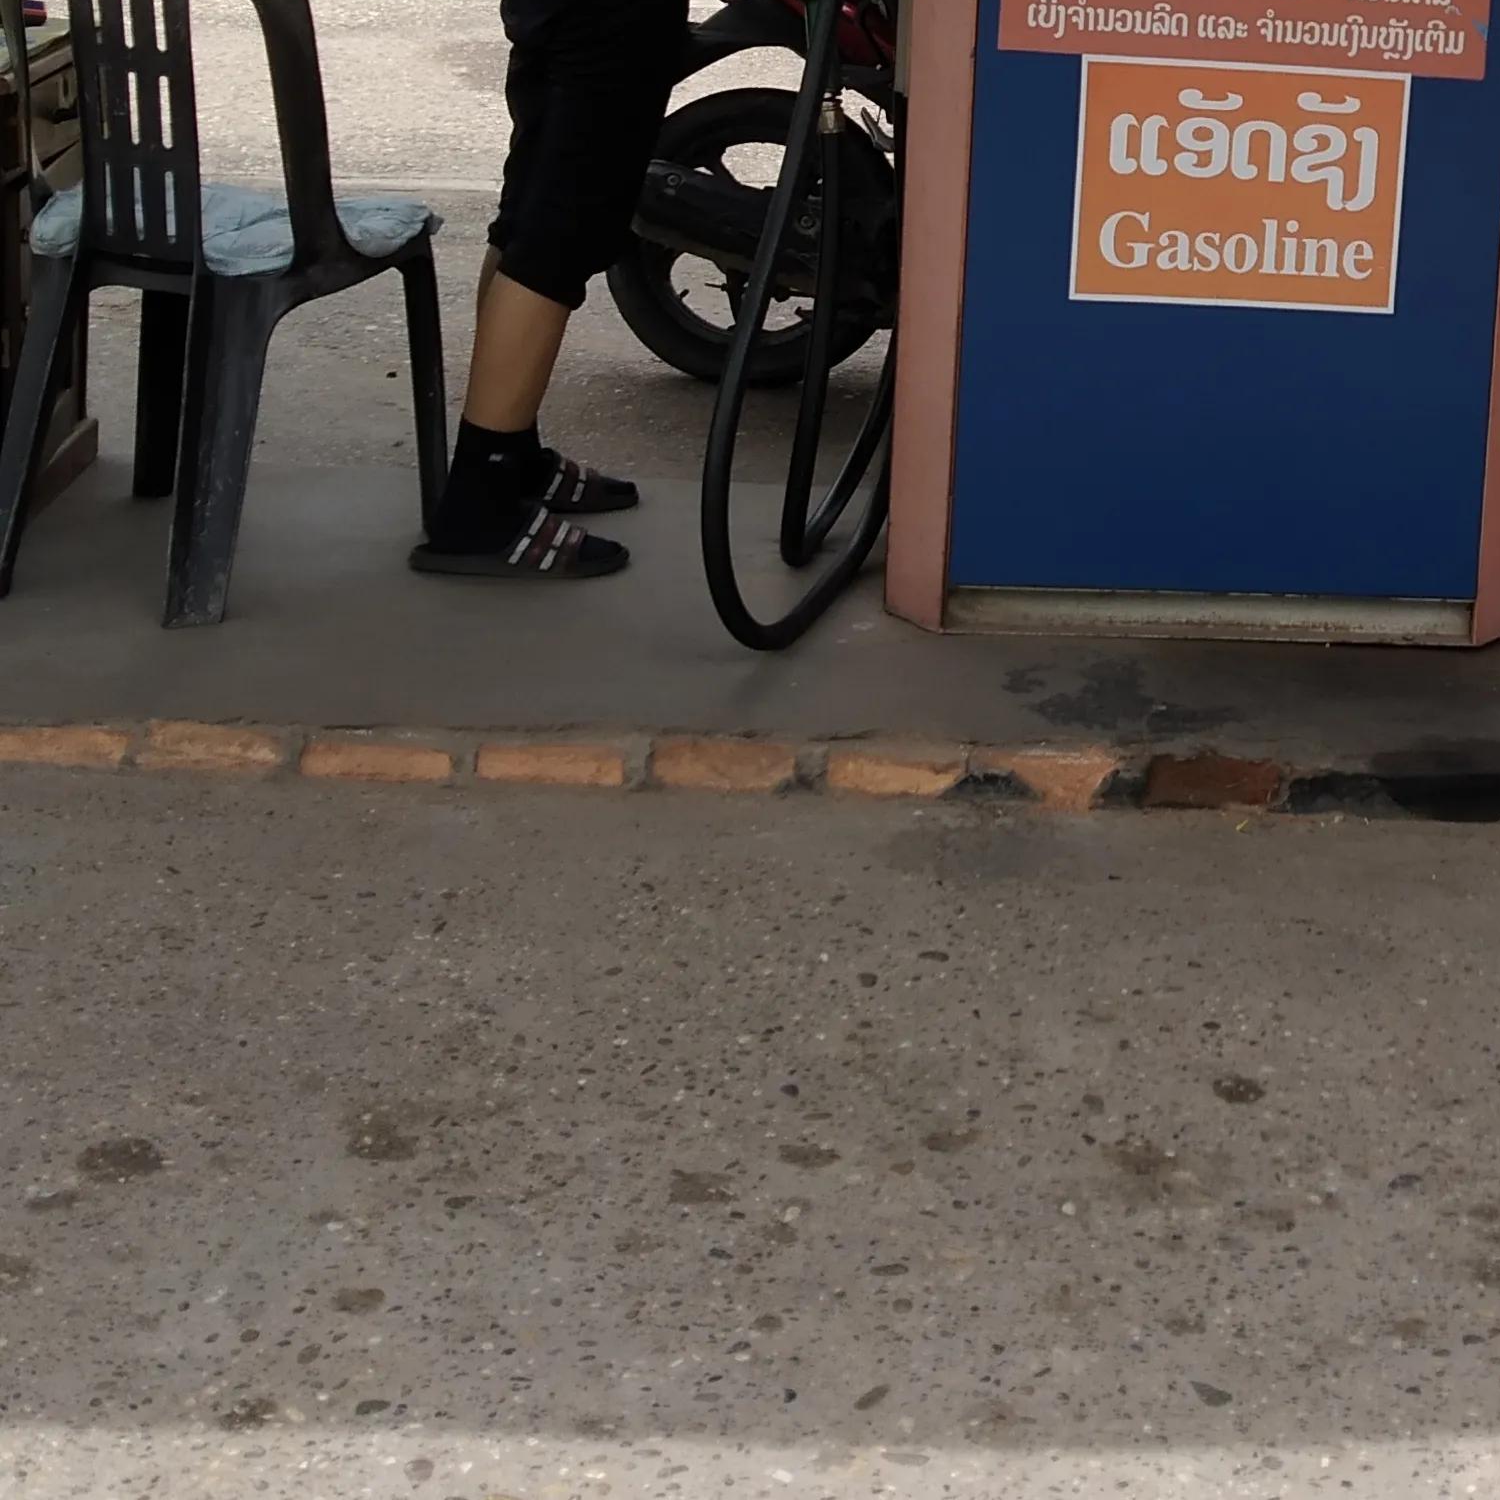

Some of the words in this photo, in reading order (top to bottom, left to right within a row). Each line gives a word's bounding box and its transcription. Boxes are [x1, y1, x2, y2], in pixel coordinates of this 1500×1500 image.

[1197, 13, 1249, 40] ແລະ
[1109, 88, 1379, 212] ແອັດຊັງ
[1099, 210, 1374, 280] Gasoline
